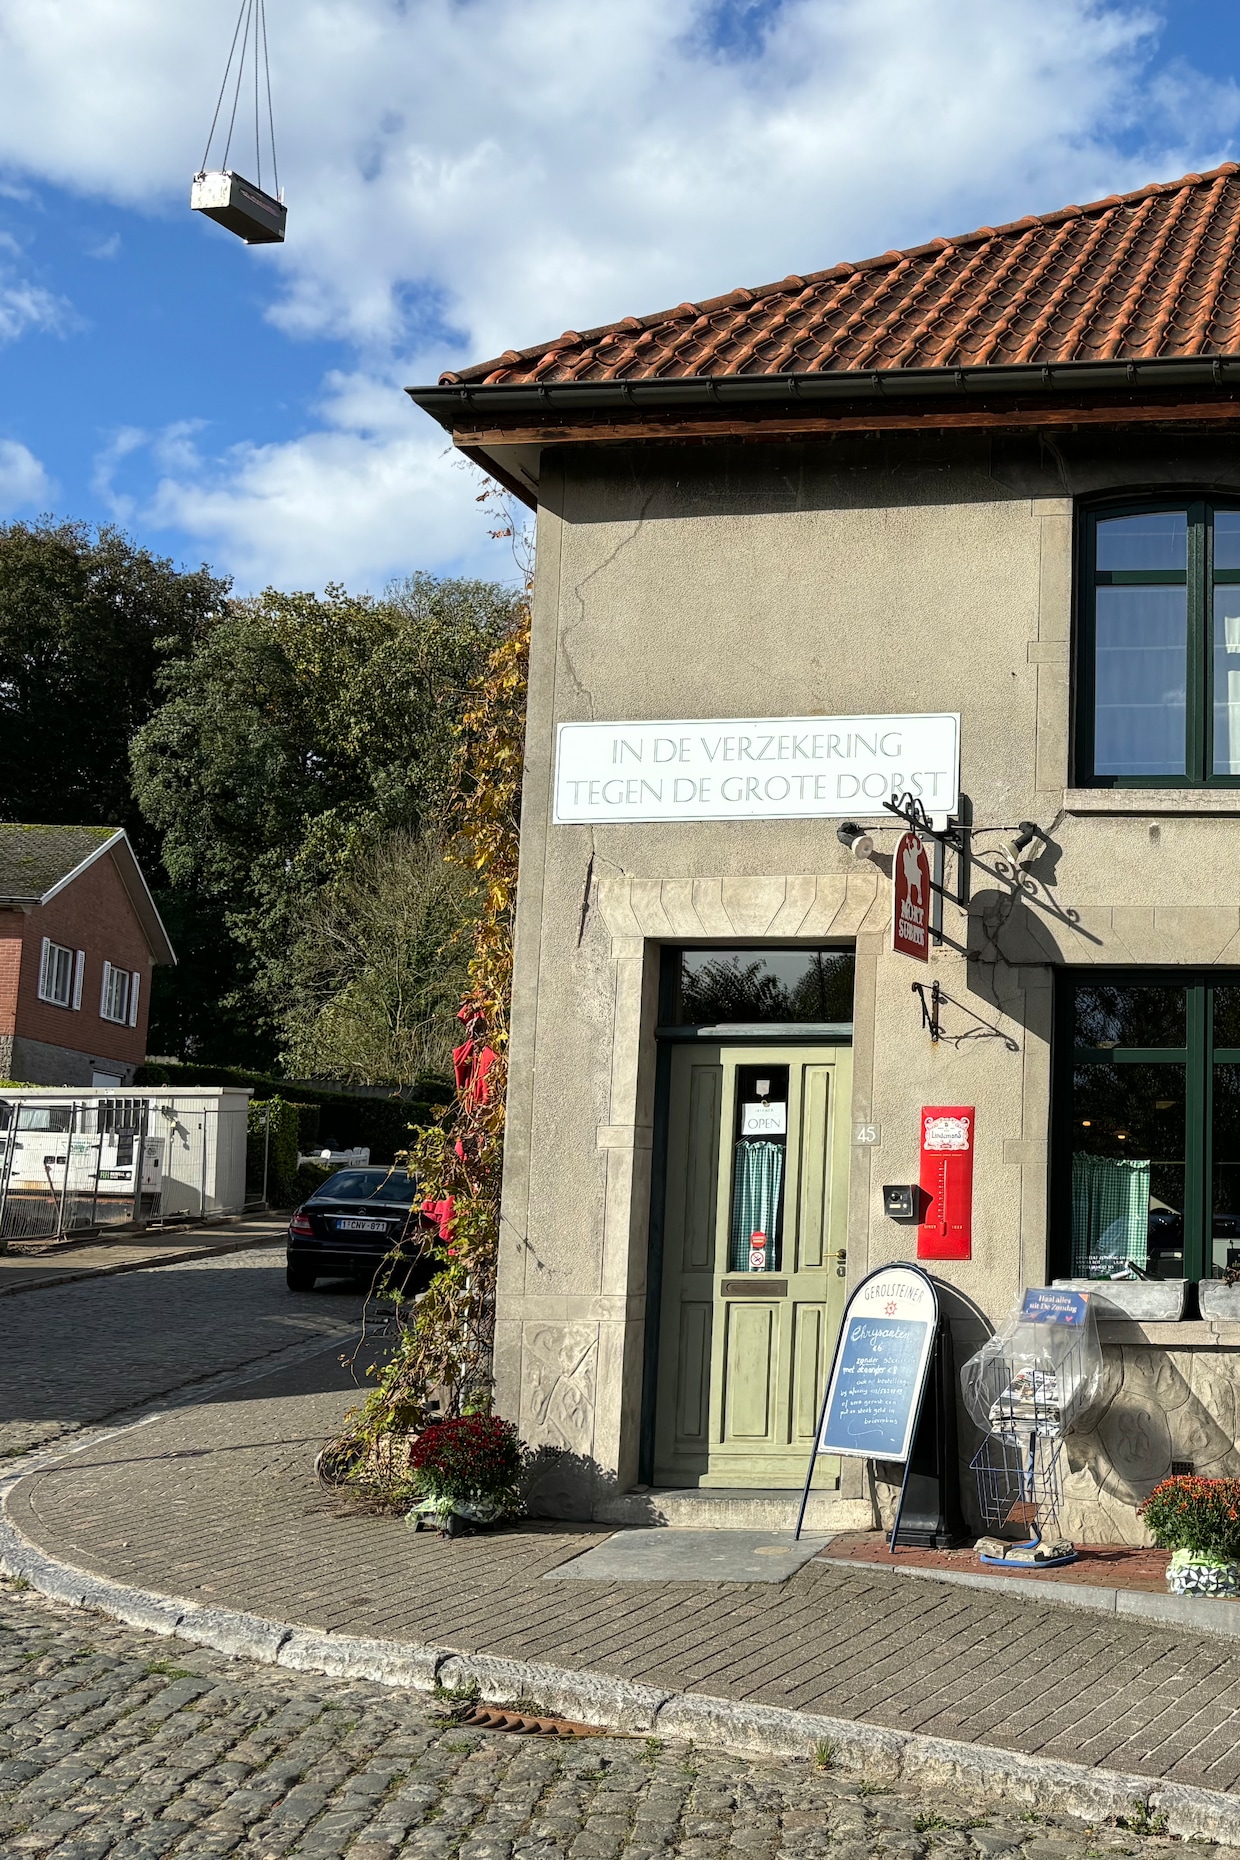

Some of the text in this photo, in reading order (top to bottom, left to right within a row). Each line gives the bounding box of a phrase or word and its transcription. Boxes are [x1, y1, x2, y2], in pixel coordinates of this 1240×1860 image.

[612, 732, 903, 764] IN DE VERZEKERING
[566, 771, 948, 806] TEGEN DE GROTE DORST
[901, 899, 925, 926] MORT
[748, 1118, 781, 1130] OPEN
[857, 1126, 876, 1142] 45
[864, 1283, 924, 1303] GEROLSTEINER
[1055, 1295, 1071, 1304] alles
